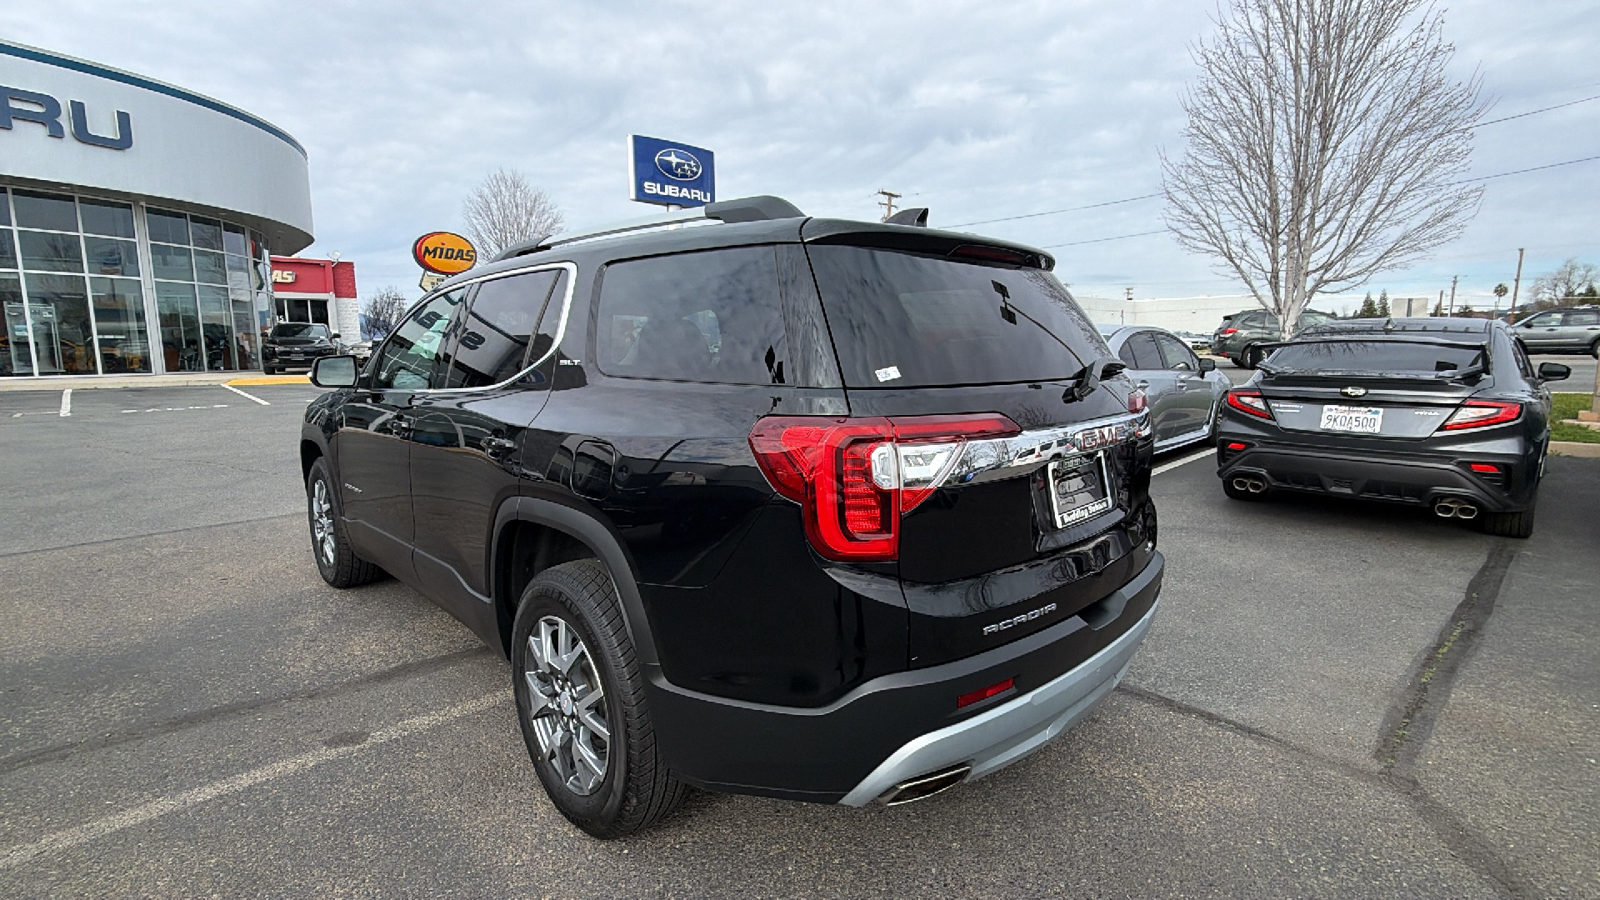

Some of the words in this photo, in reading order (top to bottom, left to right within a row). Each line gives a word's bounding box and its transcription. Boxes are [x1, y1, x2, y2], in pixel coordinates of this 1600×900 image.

[0, 85, 133, 150] RU
[643, 181, 711, 203] SUBARU
[423, 245, 476, 262] MIDAS
[1081, 425, 1126, 449] GMC
[982, 603, 1057, 636] ACADIA
